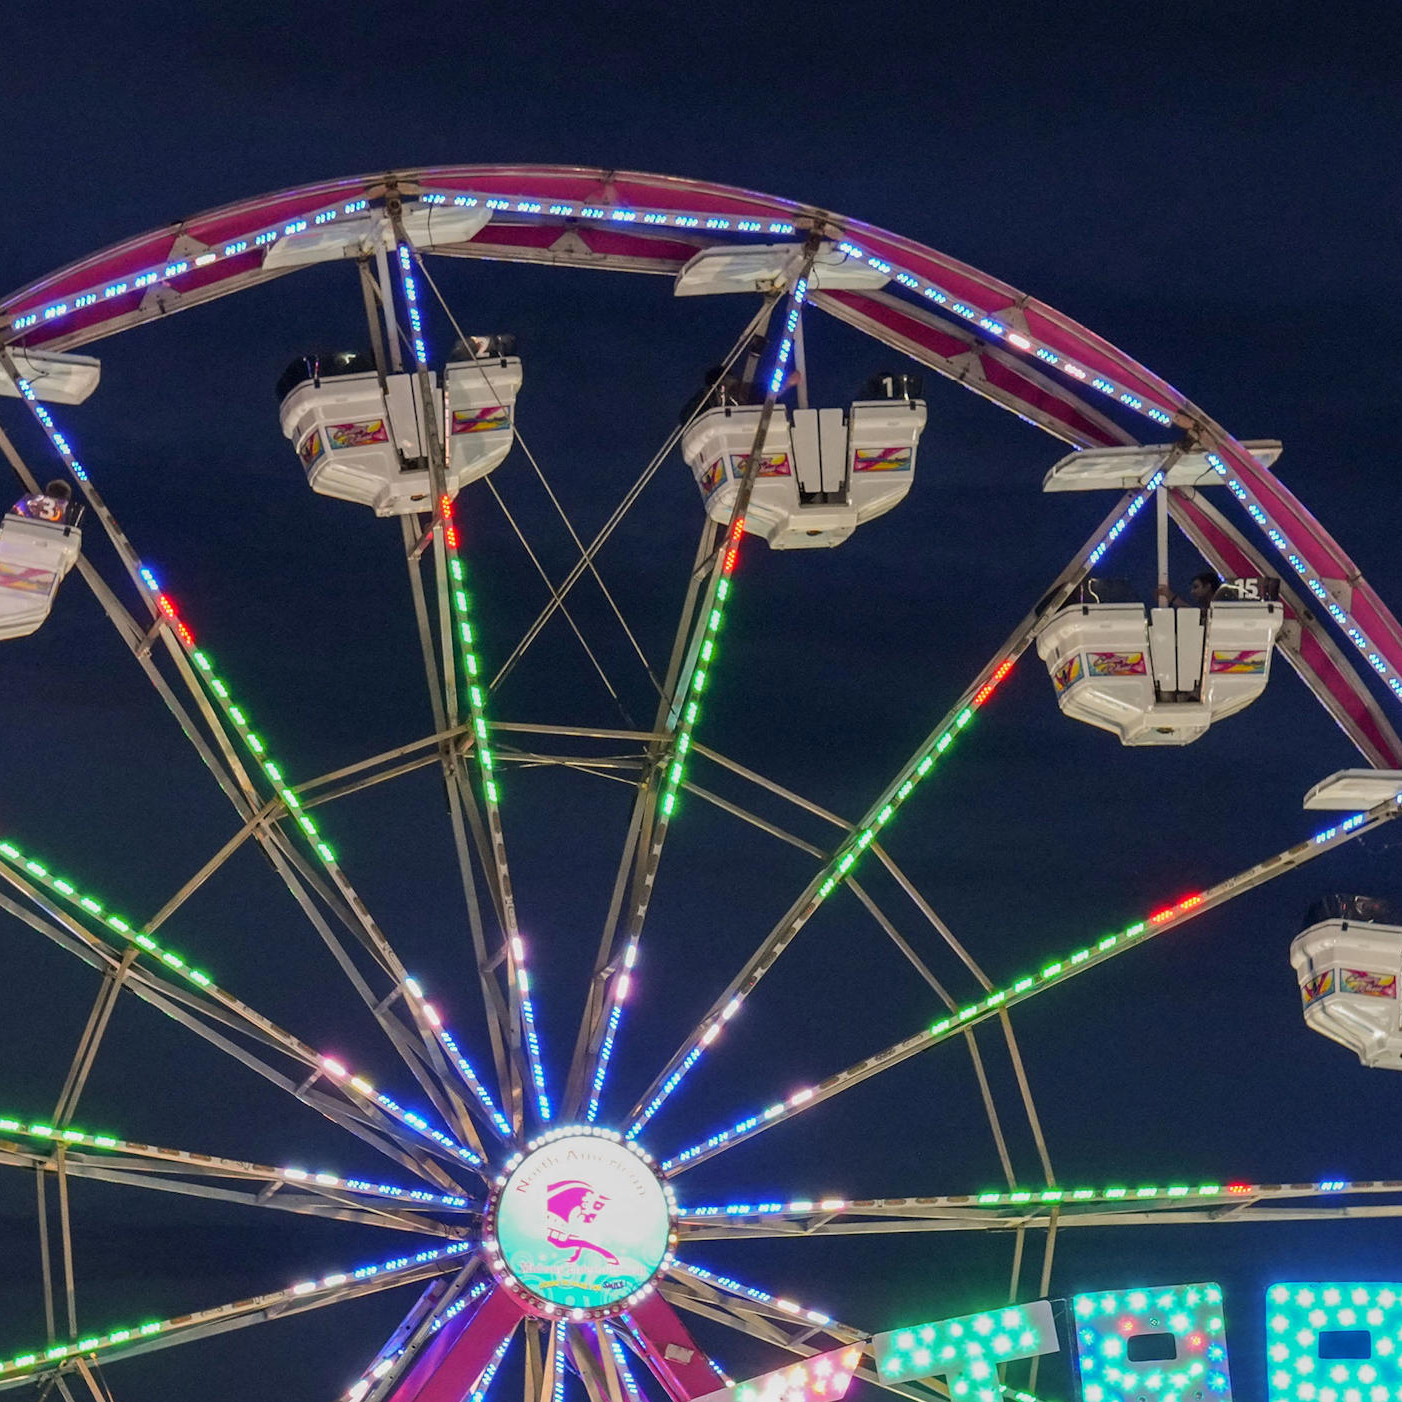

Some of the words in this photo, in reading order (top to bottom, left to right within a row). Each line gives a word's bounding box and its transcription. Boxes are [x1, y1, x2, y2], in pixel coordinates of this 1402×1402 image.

[470, 336, 490, 358] 2
[882, 376, 893, 398] 1
[39, 497, 55, 519] 3
[1234, 578, 1258, 599] 15
